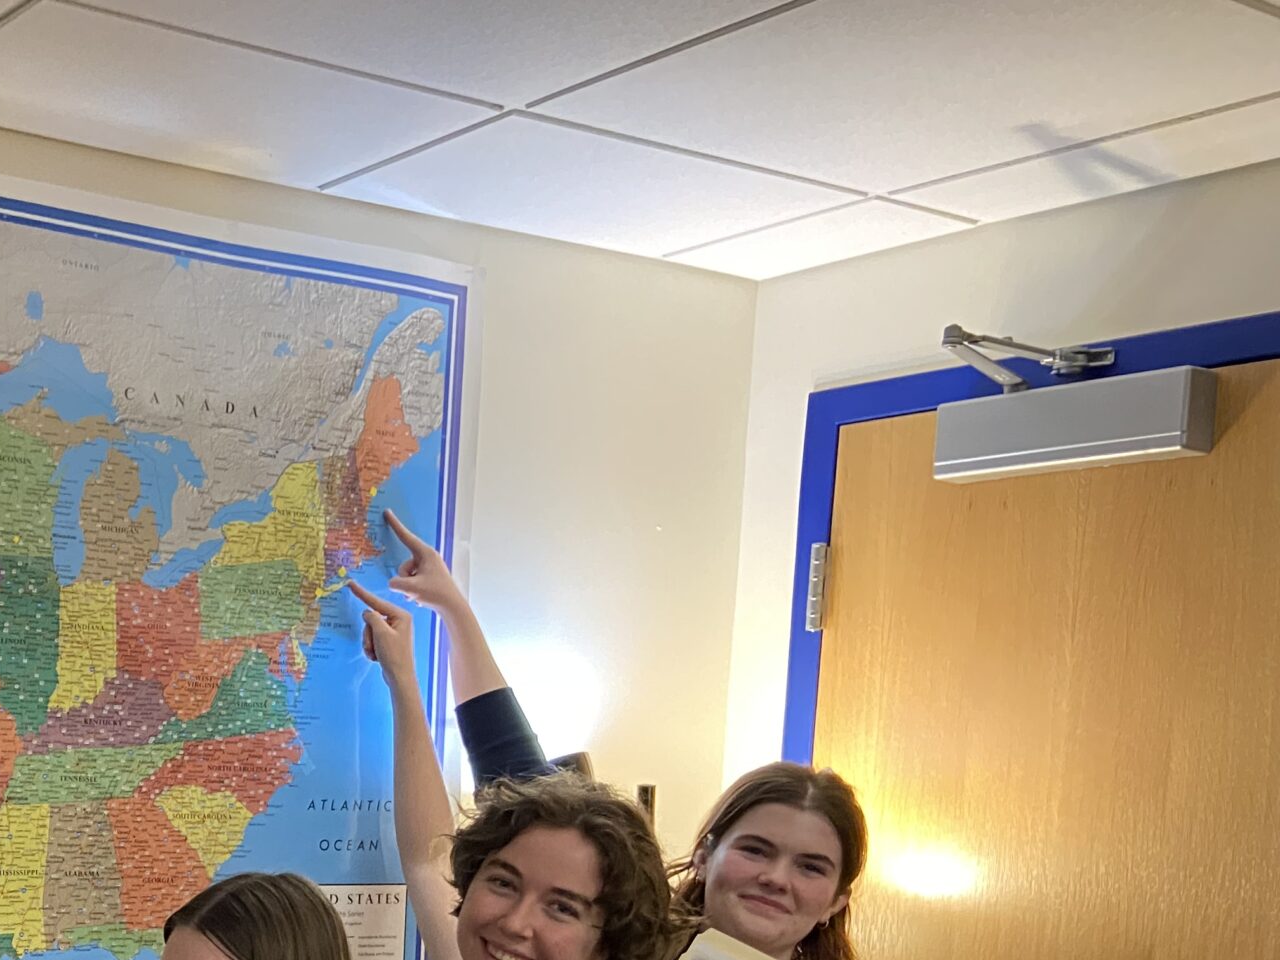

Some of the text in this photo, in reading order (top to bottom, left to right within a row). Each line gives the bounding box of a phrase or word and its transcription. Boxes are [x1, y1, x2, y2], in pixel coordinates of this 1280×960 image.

[124, 386, 259, 419] CANADA
[101, 524, 140, 536] MICHIGAN
[71, 623, 104, 632] INDIANA
[83, 717, 123, 726] KENTUCKY
[60, 775, 98, 783] TENNESSEE
[306, 798, 393, 813] ATLANTIC
[319, 838, 380, 851] OCEAN
[347, 892, 401, 905] STATES
